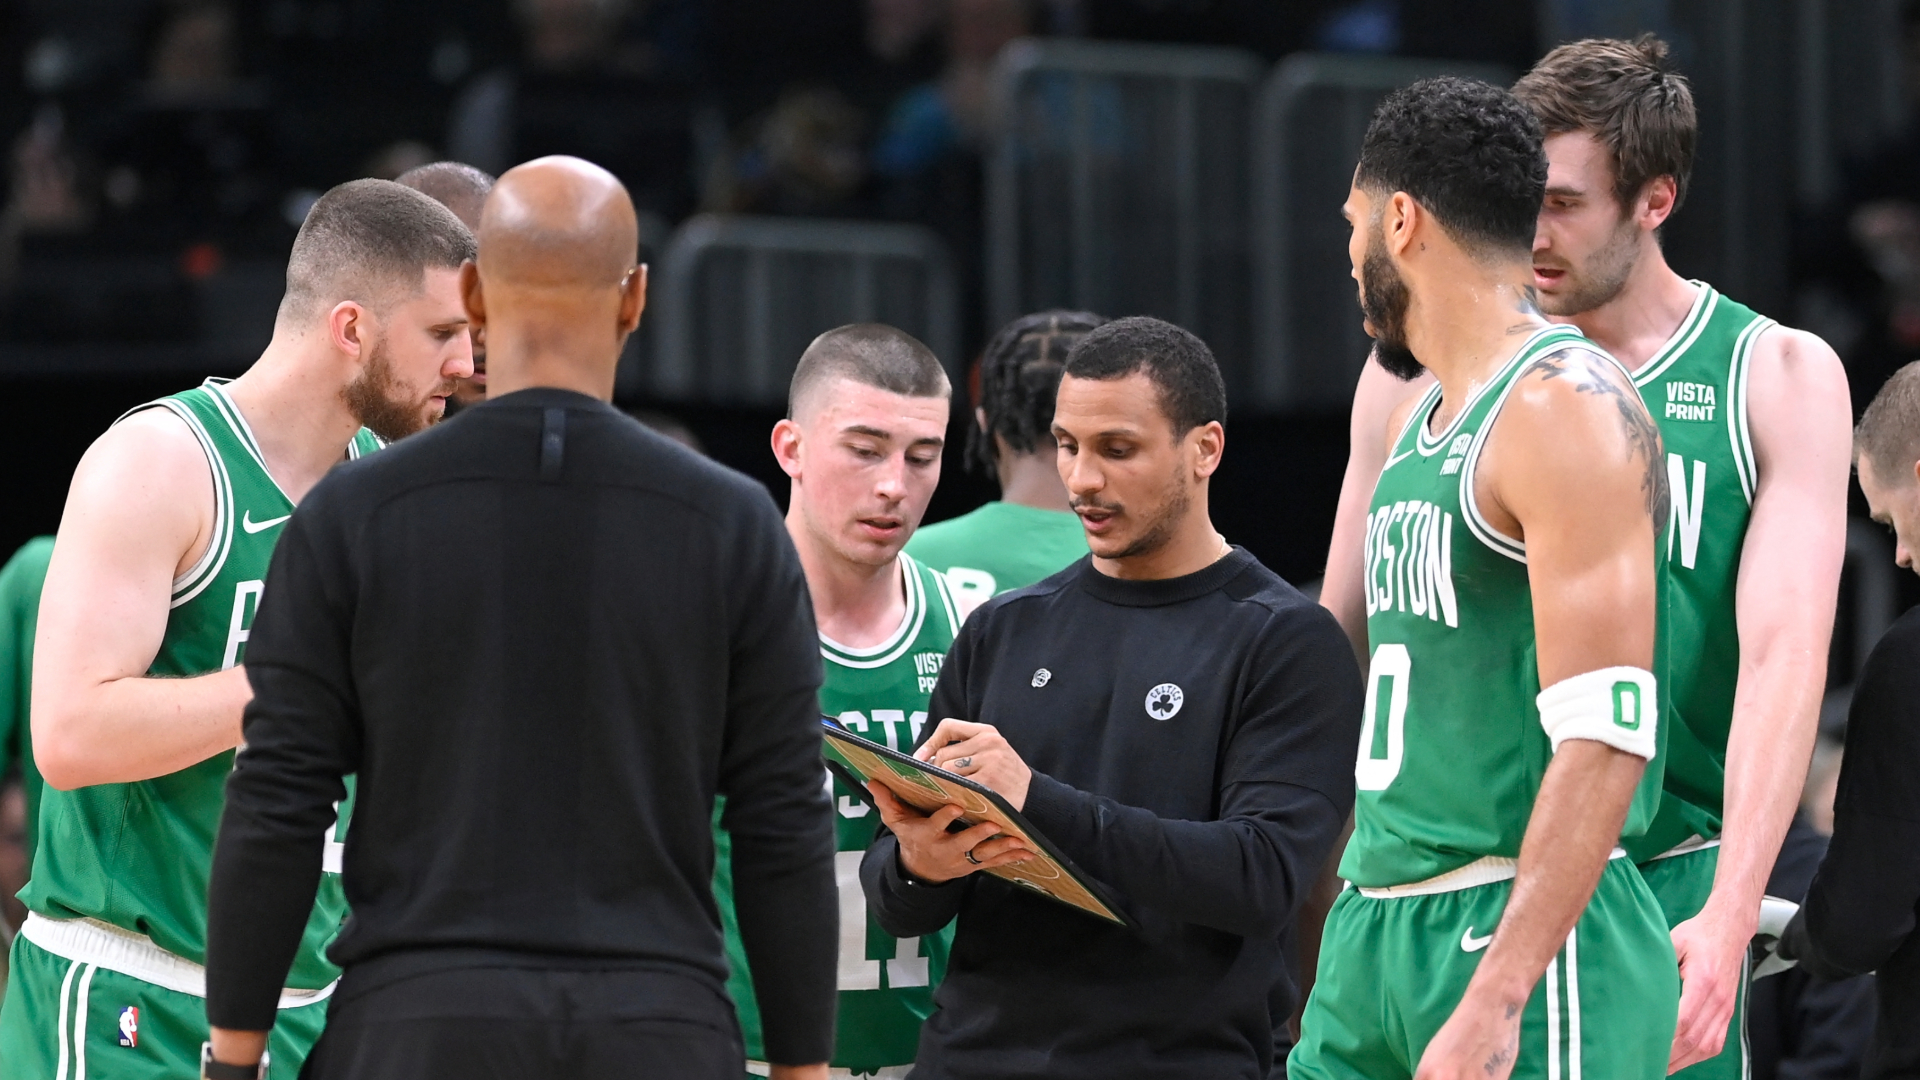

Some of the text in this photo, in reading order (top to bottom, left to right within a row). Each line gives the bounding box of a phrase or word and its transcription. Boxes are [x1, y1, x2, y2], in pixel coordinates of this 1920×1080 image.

[1666, 381, 1716, 405] VISTA
[1665, 402, 1716, 421] PRINT
[914, 652, 946, 675] VIST
[1150, 685, 1182, 701] CELTICS
[1355, 643, 1411, 791] 0
[1612, 681, 1641, 731] 0
